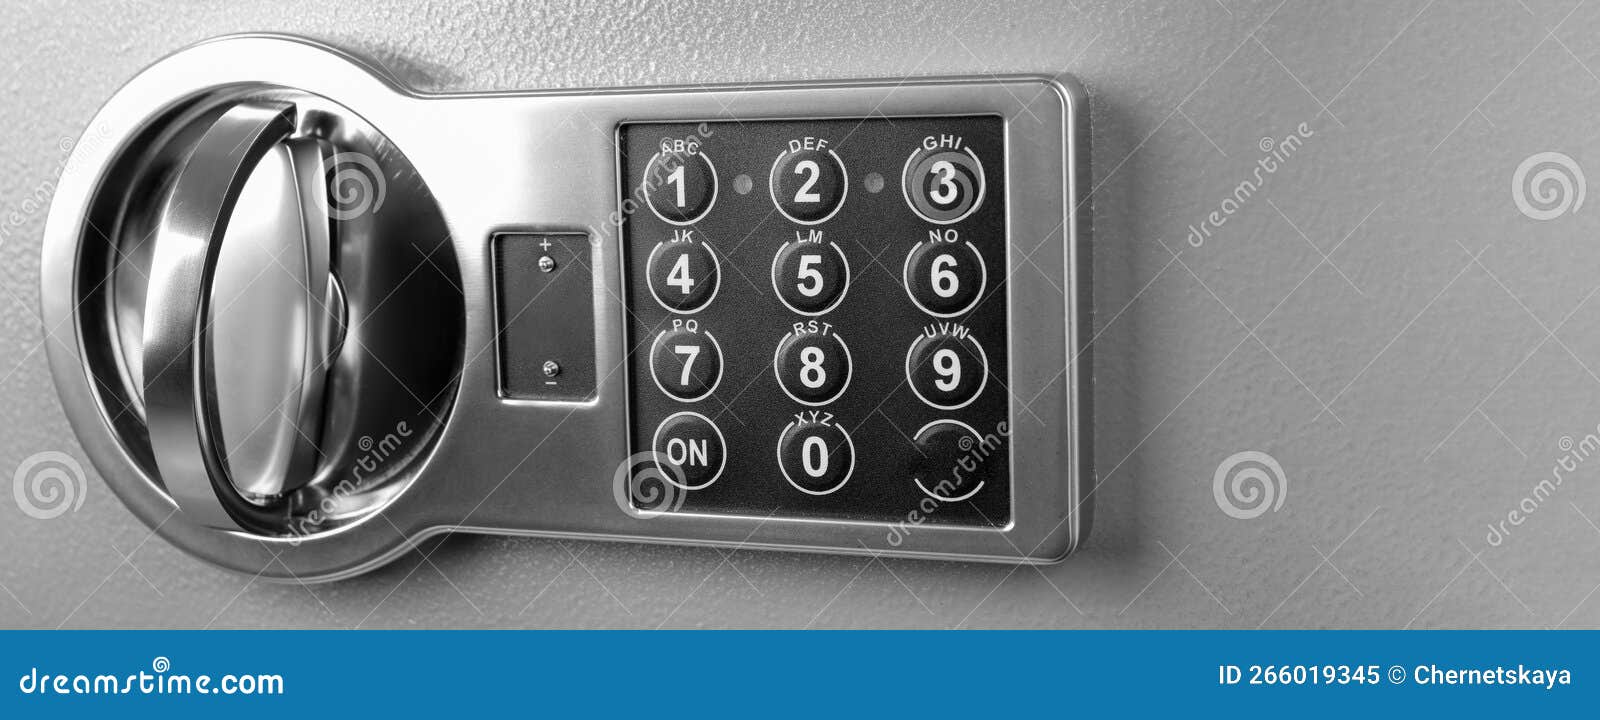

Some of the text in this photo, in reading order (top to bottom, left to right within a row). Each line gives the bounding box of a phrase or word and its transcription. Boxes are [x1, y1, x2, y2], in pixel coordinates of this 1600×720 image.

[662, 140, 698, 157] ABC
[789, 137, 828, 154] DEF
[923, 134, 961, 151] GHI
[666, 165, 686, 207] 1
[794, 160, 820, 202] 2
[931, 161, 957, 203] 3
[671, 230, 693, 244] JK
[795, 229, 822, 244] LM
[929, 229, 958, 244] NO
[667, 254, 694, 294] 4
[798, 255, 823, 296] 5
[931, 254, 958, 297] 6
[672, 319, 698, 334] PQ
[793, 320, 832, 336] RST
[924, 323, 969, 339] UVW
[675, 346, 700, 385] 7
[800, 347, 825, 388] 8
[933, 349, 960, 391] 9
[795, 411, 833, 427] XYZ
[667, 438, 707, 466] ON
[803, 437, 828, 477] 0
